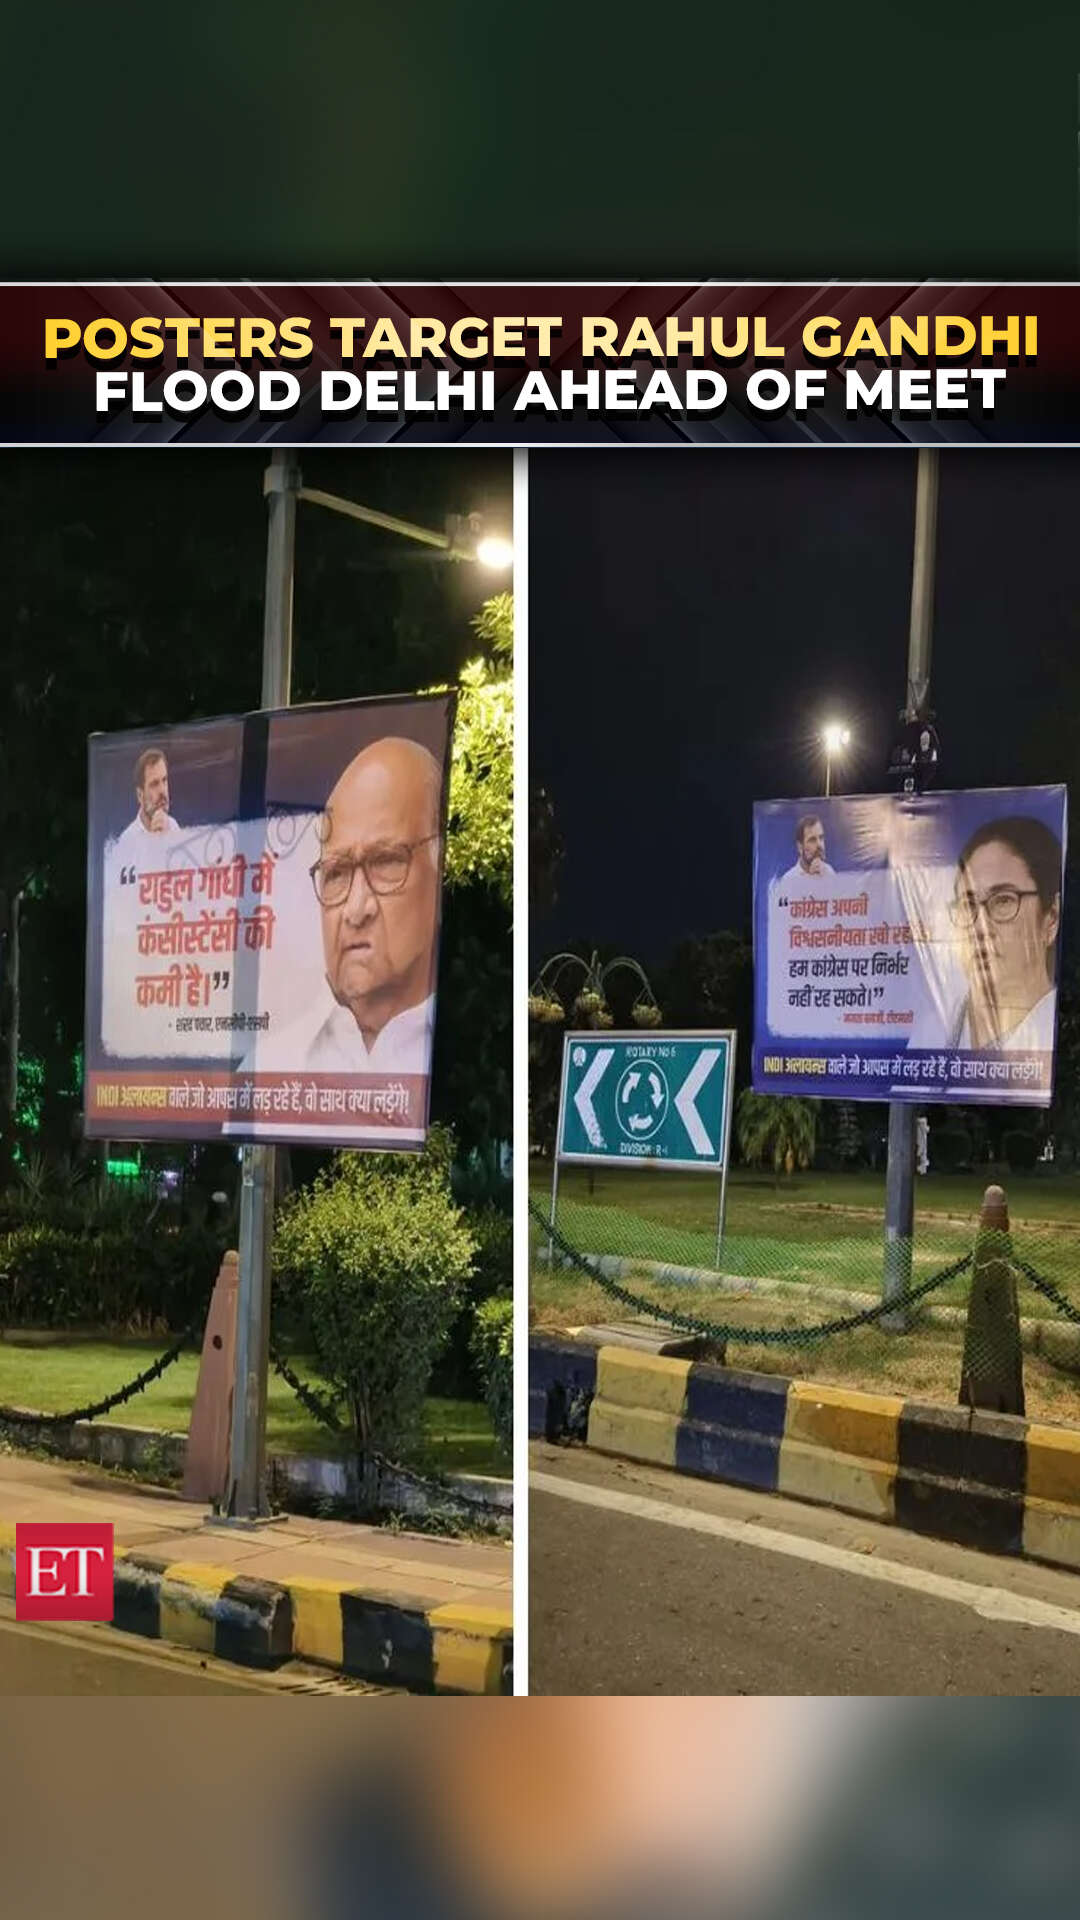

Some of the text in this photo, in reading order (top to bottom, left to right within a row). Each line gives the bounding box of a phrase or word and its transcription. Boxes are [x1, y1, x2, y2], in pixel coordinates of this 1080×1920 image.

[199, 853, 248, 899] गांधी
[251, 852, 279, 895] में
[831, 892, 868, 917] अपनी
[137, 905, 276, 956] कंसीस्टेंसी की
[789, 924, 866, 949] विश्वसनीयता
[869, 921, 889, 946] खो
[788, 951, 910, 978] हम कांग्रेस पर निर्भर
[135, 963, 184, 1008] कमी
[788, 984, 813, 1008] नहीं
[814, 988, 831, 1007] रह
[764, 1056, 783, 1073] INDI
[828, 1054, 846, 1075] वाले
[848, 1054, 860, 1075] जो
[862, 1058, 889, 1076] आपस
[891, 1054, 903, 1076] में
[903, 1059, 920, 1080] लड़
[922, 1056, 936, 1078] रहे
[950, 1056, 961, 1078] वो
[963, 1061, 987, 1079] साथ
[989, 1061, 1009, 1079] क्या
[169, 1080, 190, 1109] वाले
[191, 1081, 204, 1109] जो
[207, 1087, 237, 1111] आपस
[239, 1081, 253, 1111] में
[252, 1087, 272, 1116] लड़
[273, 1082, 290, 1111] रहे
[305, 1081, 317, 1112] वो
[320, 1089, 346, 1113] साथ
[348, 1089, 372, 1113] क्या
